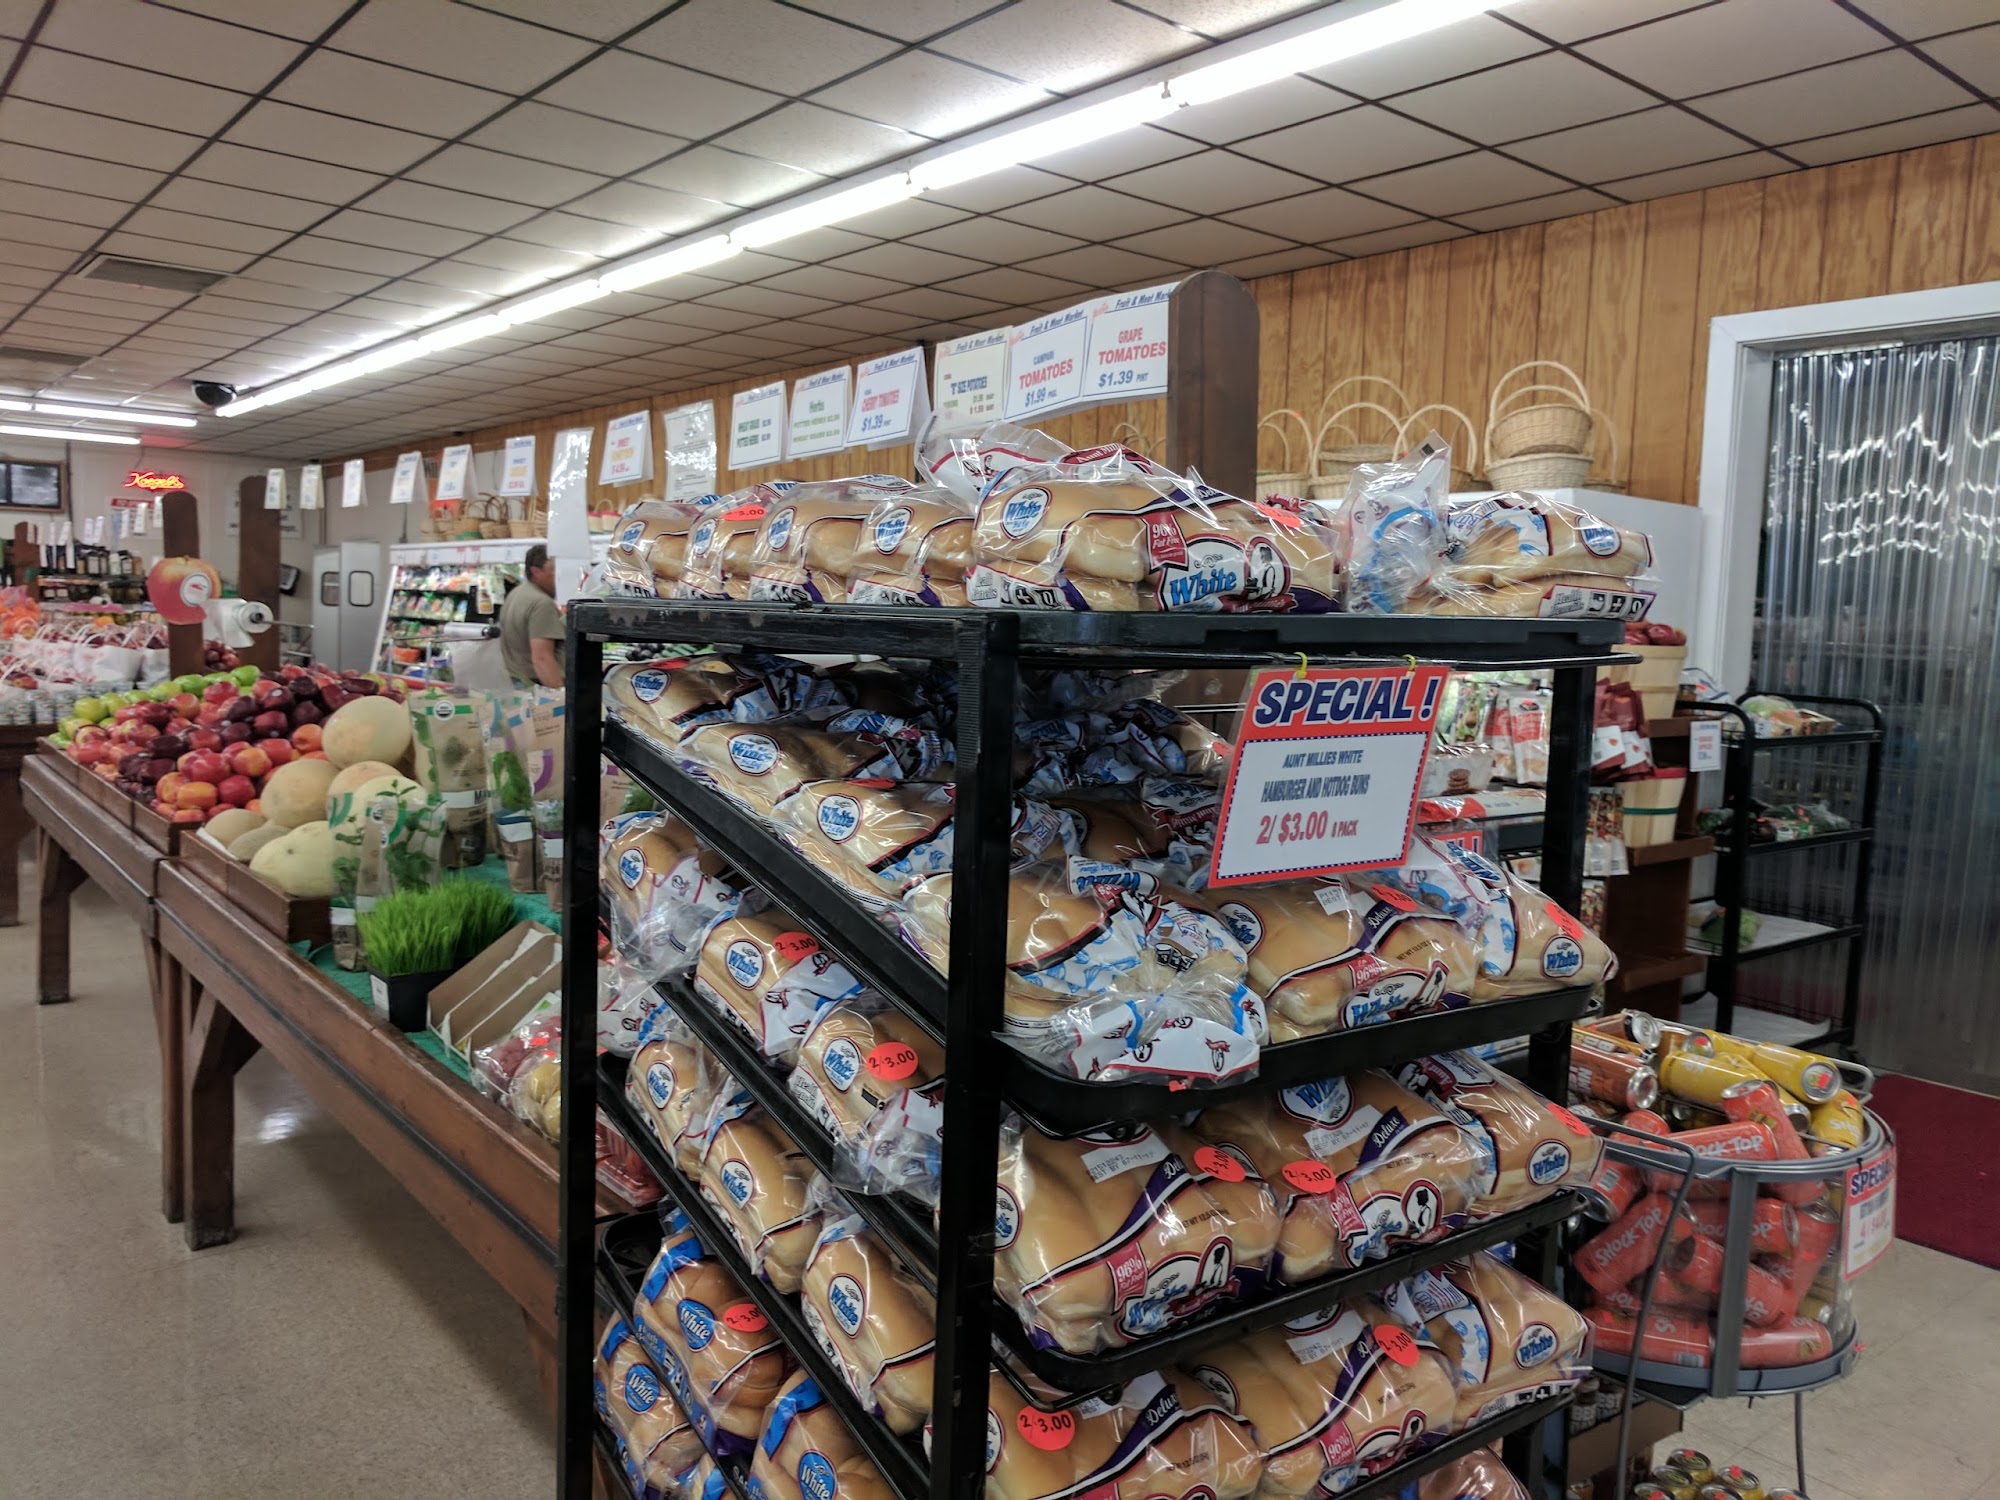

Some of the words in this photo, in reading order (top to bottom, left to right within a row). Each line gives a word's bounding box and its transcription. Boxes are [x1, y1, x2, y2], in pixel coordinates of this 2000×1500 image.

[1155, 289, 1172, 301] Mark
[1118, 327, 1143, 343] GRAPE
[1098, 341, 1167, 365] TOMATOES
[1019, 358, 1073, 390] TOMATOES
[1098, 370, 1134, 388] $1.39
[1025, 387, 1046, 408] $1.99
[1077, 449, 1099, 463] Aunt
[1005, 500, 1042, 522] White
[1169, 567, 1237, 606] White
[1282, 753, 1306, 768] AUNT
[1307, 751, 1337, 767] MILLIES
[1338, 750, 1364, 765] WHITE
[1261, 778, 1306, 803] HAMBURGER
[1306, 777, 1320, 799] AND
[1320, 776, 1350, 798] HOTDOG
[1350, 774, 1371, 795] BUNS
[820, 805, 855, 828] White
[1277, 810, 1329, 846] $3.00
[1337, 820, 1359, 837] PACK
[621, 856, 640, 880] White
[1368, 906, 1394, 929] Deluxe
[728, 950, 759, 978] White
[1546, 950, 1580, 970] White
[824, 1048, 855, 1080] White
[648, 1070, 669, 1100] White
[1373, 1116, 1401, 1148] Deluxe
[1532, 1153, 1567, 1179] White
[723, 1170, 748, 1202] White
[1596, 1229, 1640, 1266] SHOCK
[1637, 1208, 1664, 1232] TOP
[1116, 1256, 1143, 1281] 96%
[831, 1284, 859, 1326] White
[681, 1307, 711, 1340] White
[1519, 1334, 1553, 1363] White
[629, 1373, 655, 1404] White
[801, 1464, 831, 1500] White
